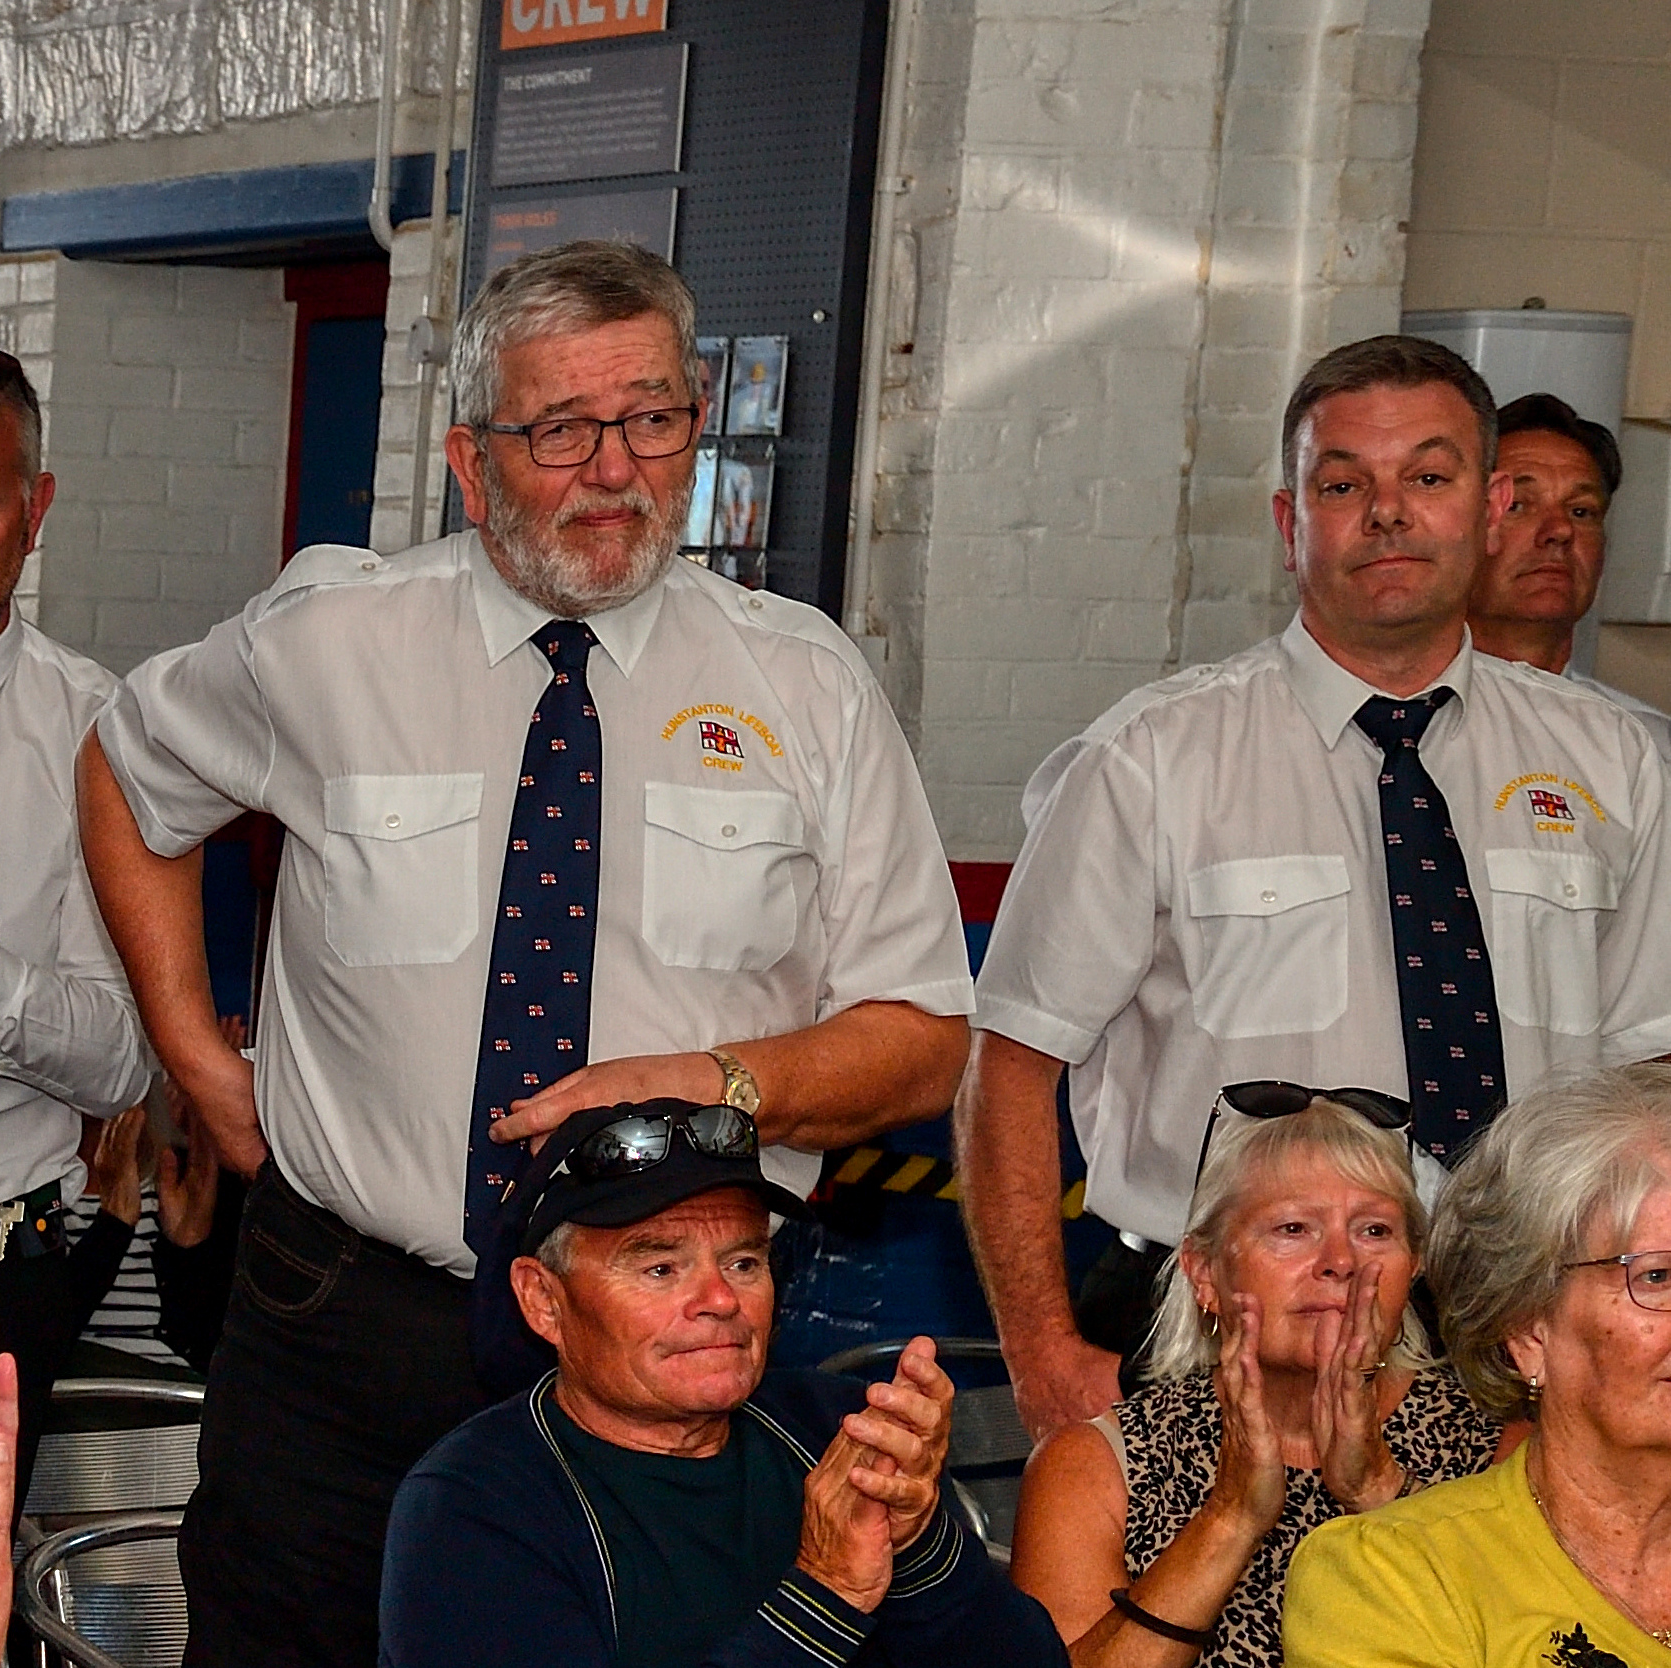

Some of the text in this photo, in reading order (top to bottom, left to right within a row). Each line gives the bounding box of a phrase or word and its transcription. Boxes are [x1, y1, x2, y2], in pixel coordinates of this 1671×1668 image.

[660, 703, 735, 741] HUNSTANTON
[702, 756, 743, 772] CREW
[1535, 821, 1575, 834] CREW
